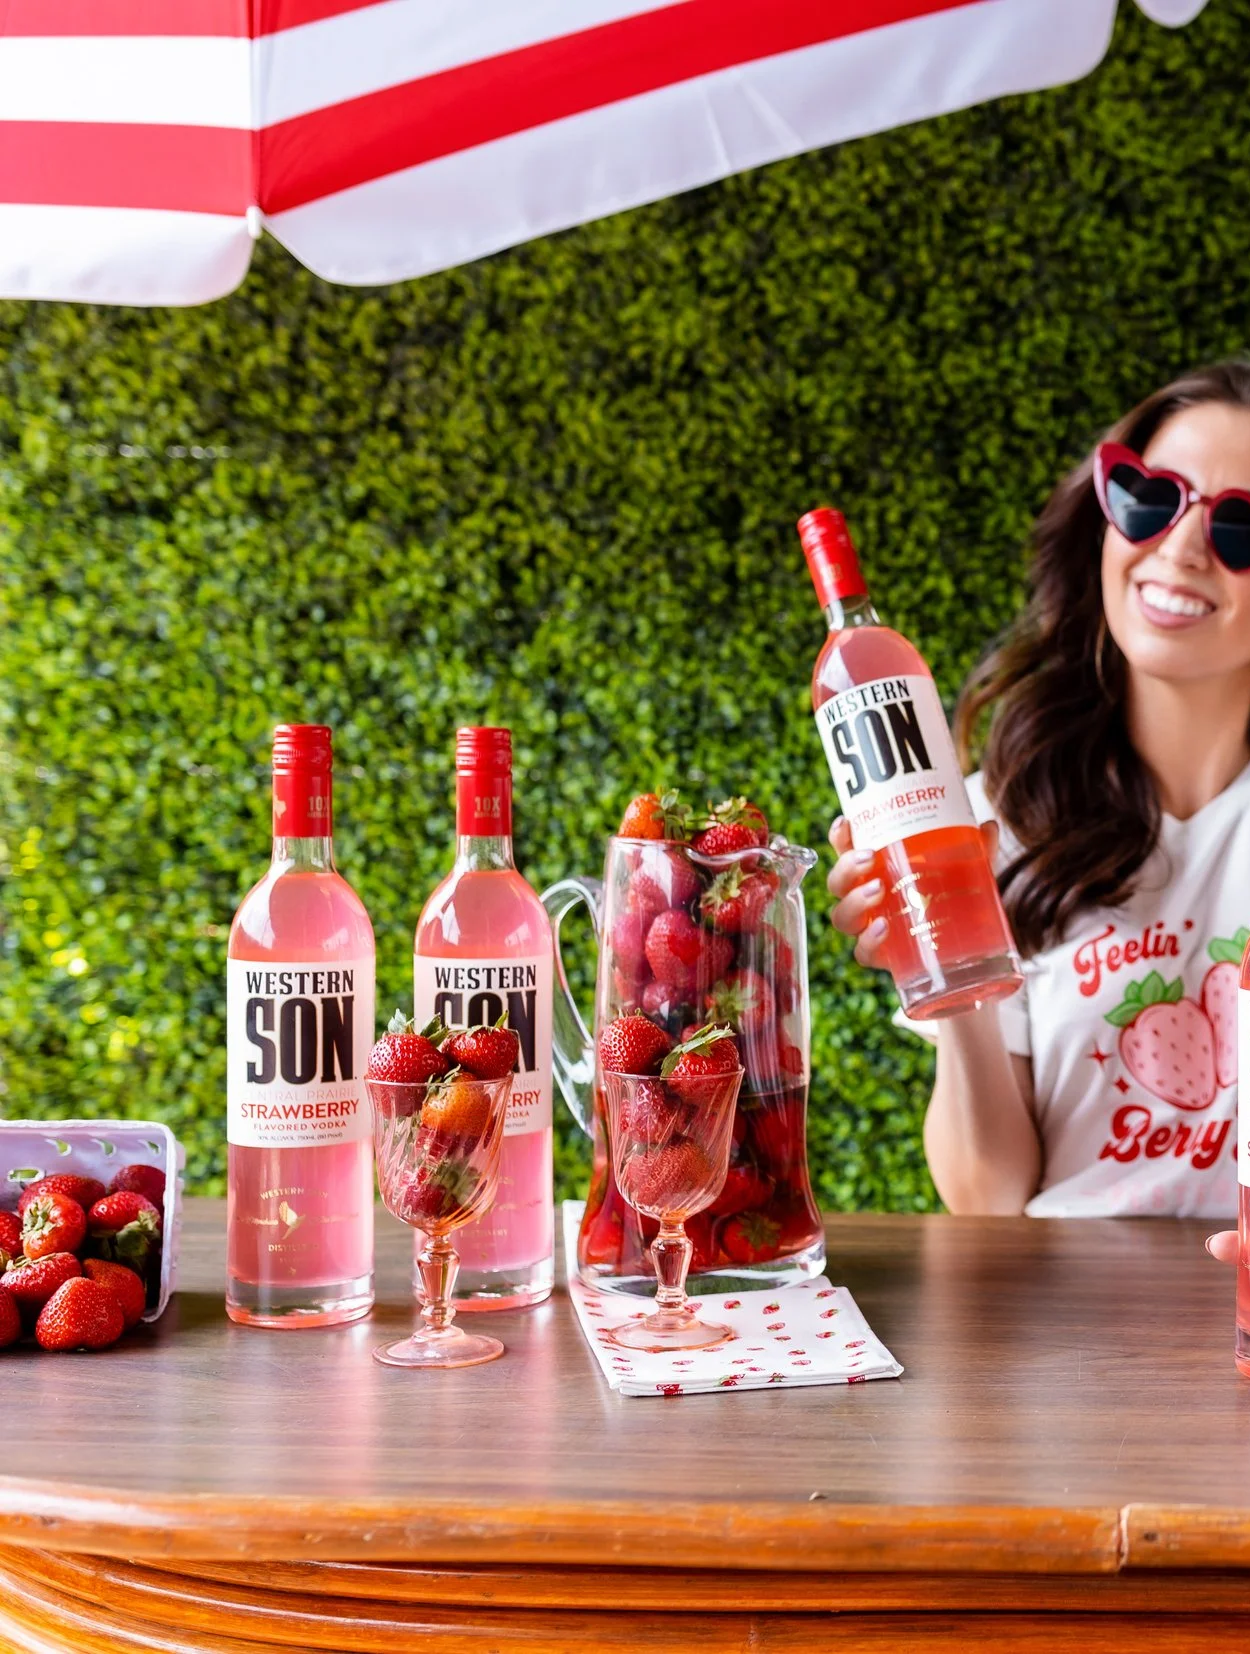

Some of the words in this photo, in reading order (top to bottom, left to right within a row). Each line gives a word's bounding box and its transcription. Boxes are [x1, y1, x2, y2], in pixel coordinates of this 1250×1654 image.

[824, 679, 910, 725] WESTERN
[831, 699, 933, 799] SON
[474, 796, 500, 810] 10X
[852, 785, 946, 831] STRAWBERRY
[434, 964, 536, 989] WESTERN
[1073, 918, 1194, 998] Feelin'
[246, 969, 354, 995] WESTERN
[245, 995, 355, 1085] SON
[240, 1099, 359, 1119] STRAWBERRY
[253, 1123, 307, 1131] FLAVORED
[311, 1121, 347, 1130] VODKA
[1098, 1105, 1233, 1170] Berry
